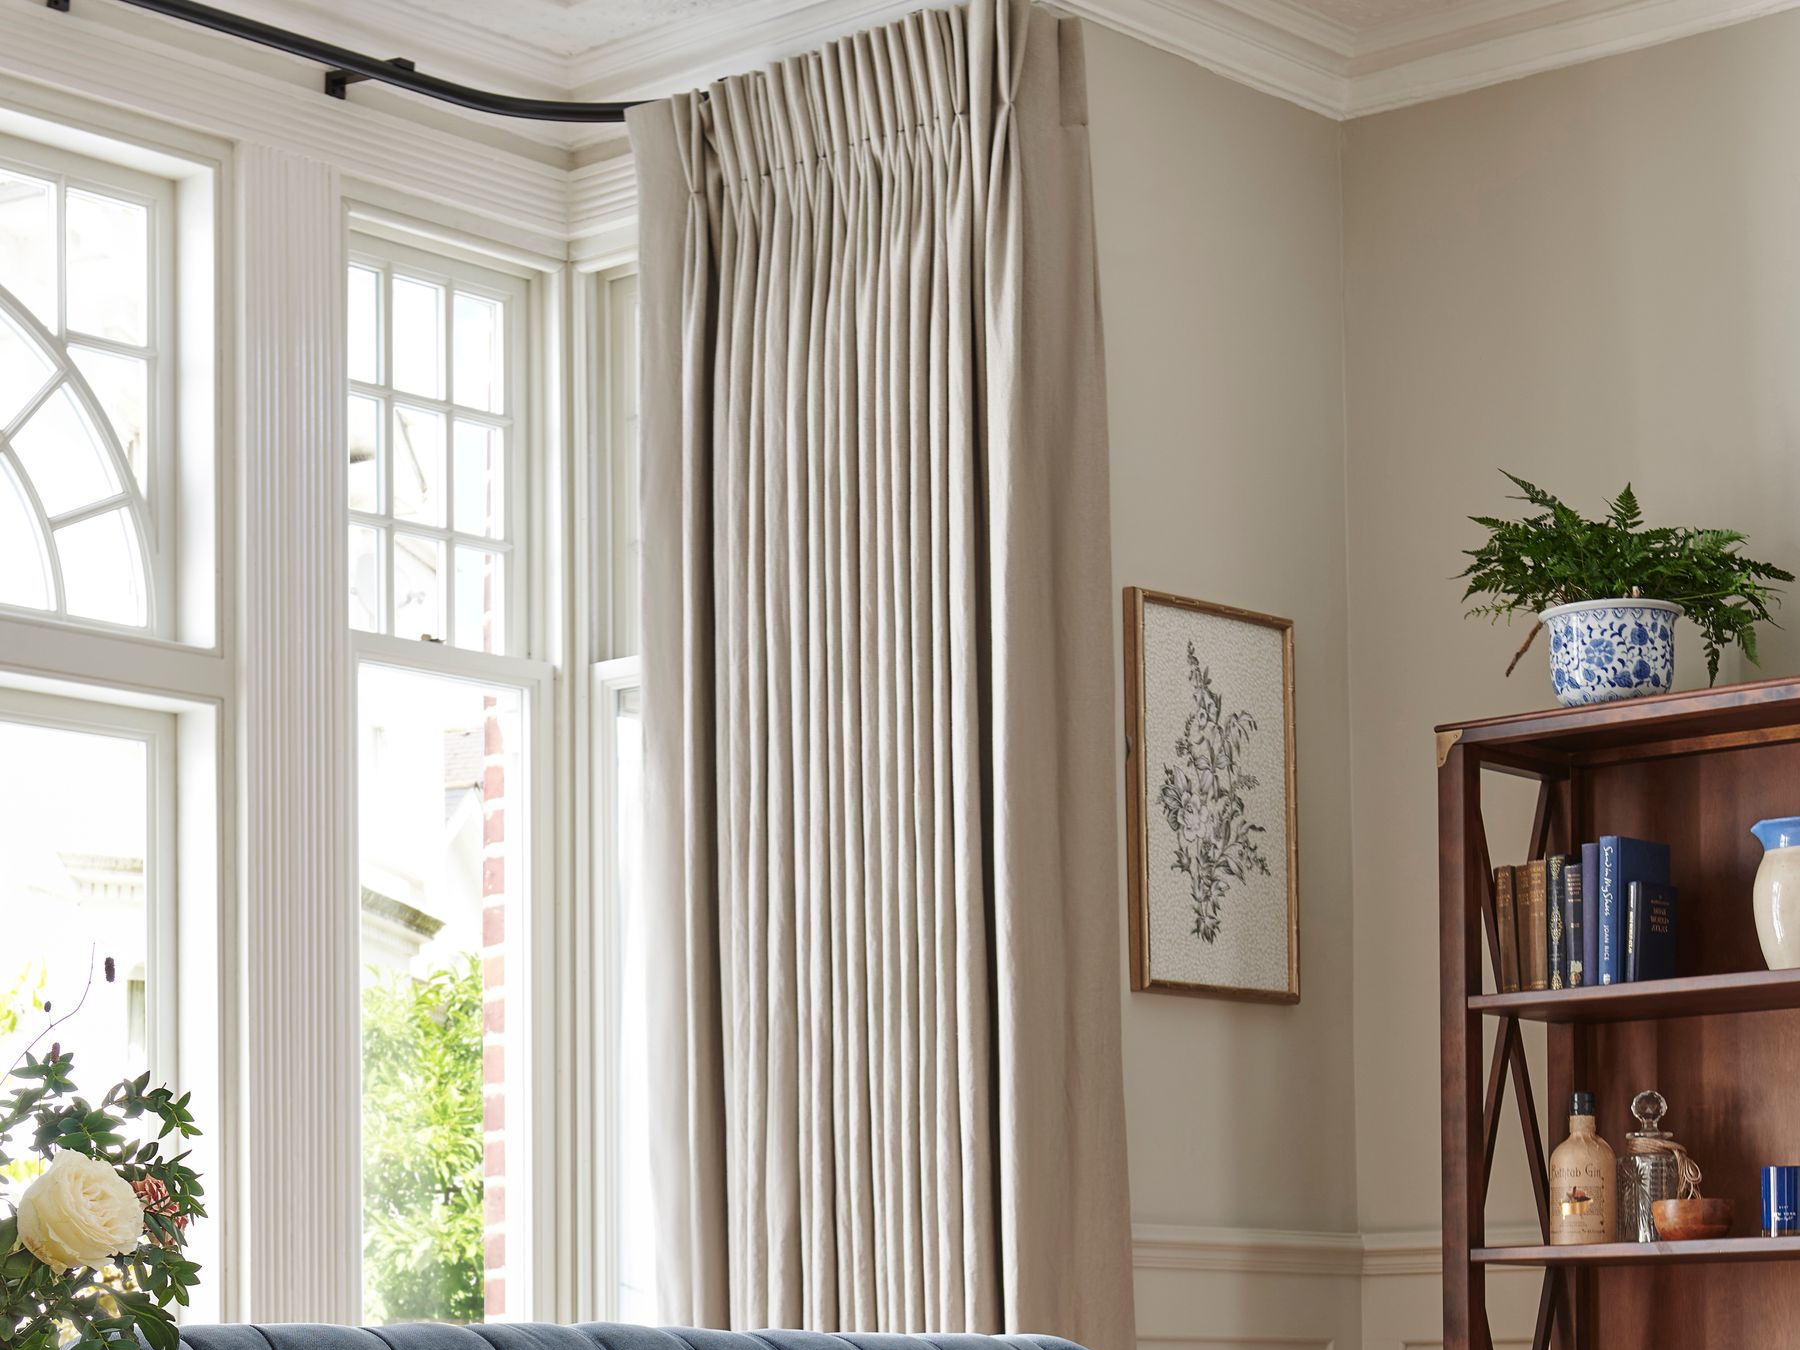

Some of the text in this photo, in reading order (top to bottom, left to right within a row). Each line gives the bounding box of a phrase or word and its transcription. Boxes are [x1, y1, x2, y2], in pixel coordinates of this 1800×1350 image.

[1603, 846, 1613, 867] Sand
[1601, 878, 1612, 892] My
[1602, 891, 1613, 917] Shoes
[1585, 1163, 1601, 1178] Gin
